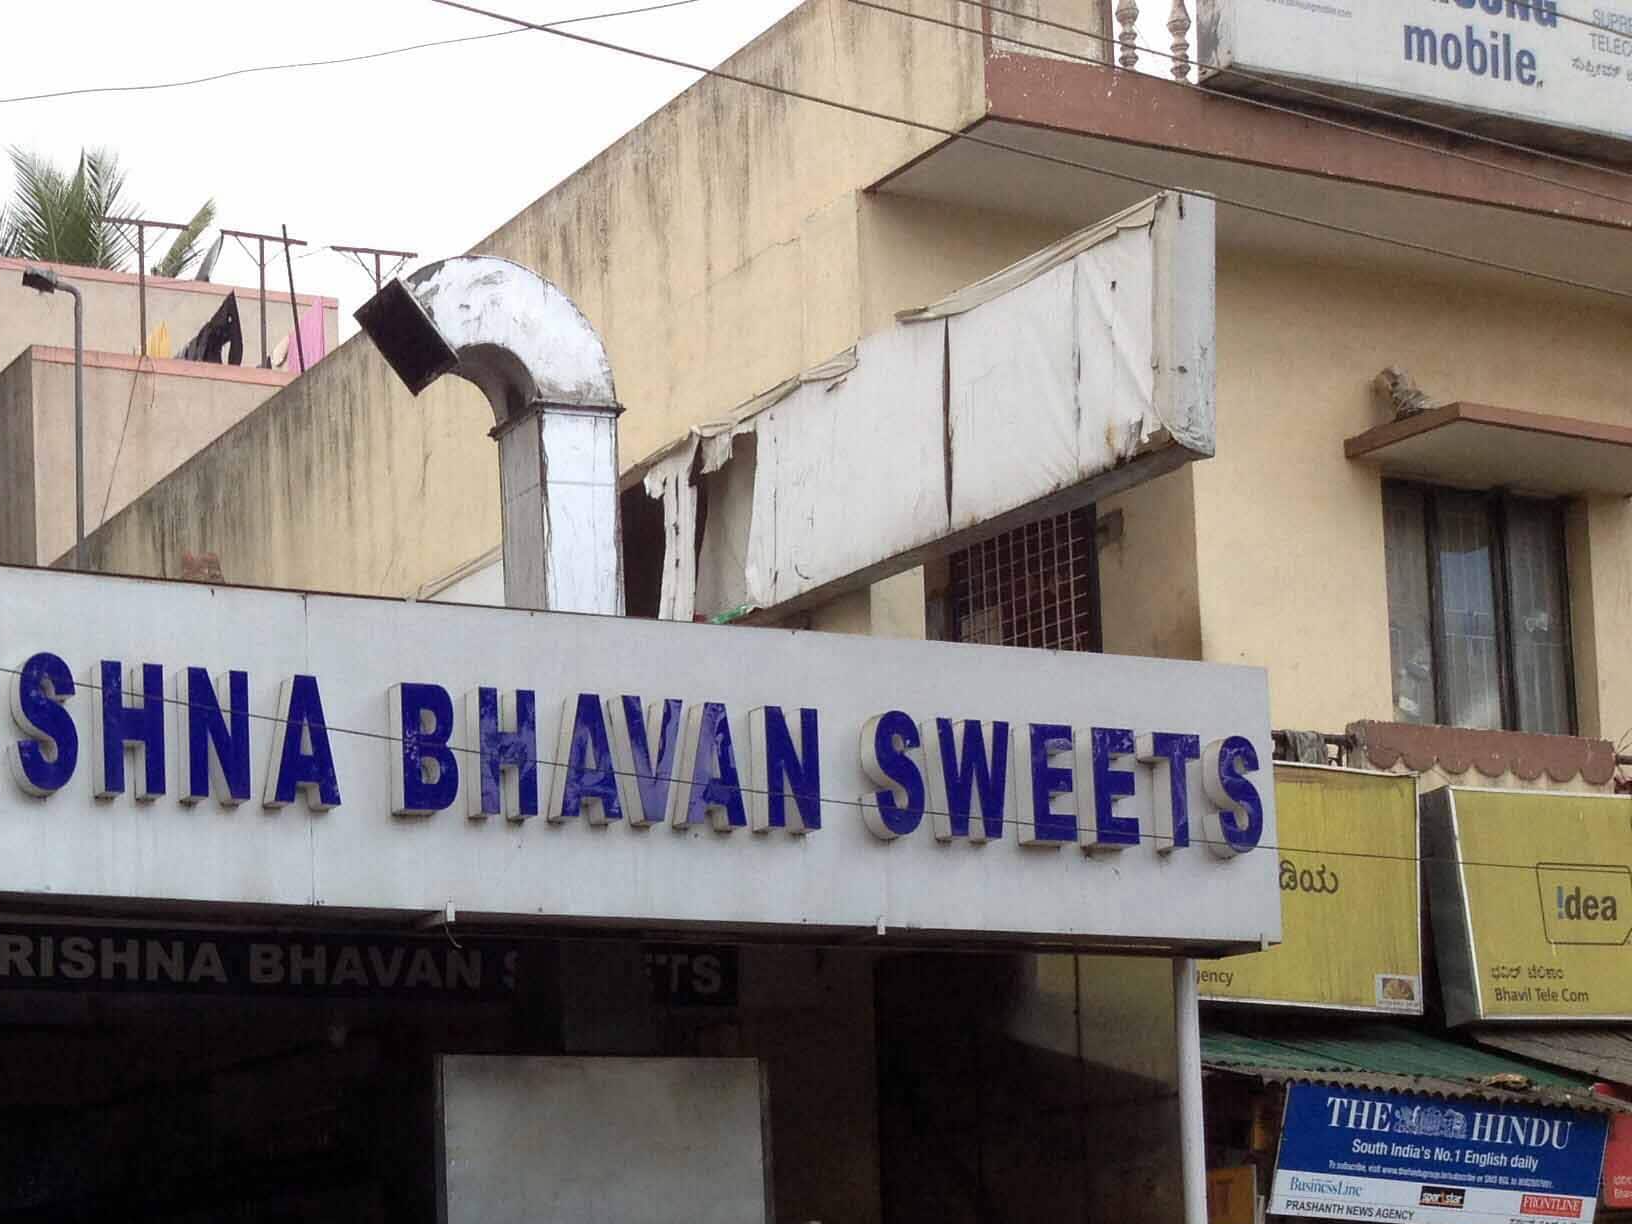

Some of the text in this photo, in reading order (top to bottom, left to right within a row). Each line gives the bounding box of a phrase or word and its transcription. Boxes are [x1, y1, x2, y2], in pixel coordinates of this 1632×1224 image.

[1404, 24, 1537, 86] mobile
[387, 681, 824, 837] BHAVAN
[859, 708, 1265, 861] SWEETS
[247, 942, 482, 992] BHAVAN
[1534, 987, 1559, 1002] Tele
[1561, 988, 1590, 1003] Com
[1326, 1096, 1574, 1150] THE HINDU
[1351, 1138, 1540, 1173] South India's No.1 English daily
[1289, 1175, 1363, 1198] BusinessLine
[1523, 1194, 1580, 1212] FRONTLINE
[1285, 1199, 1416, 1221] PRASHANTH NEWS AGENCY
